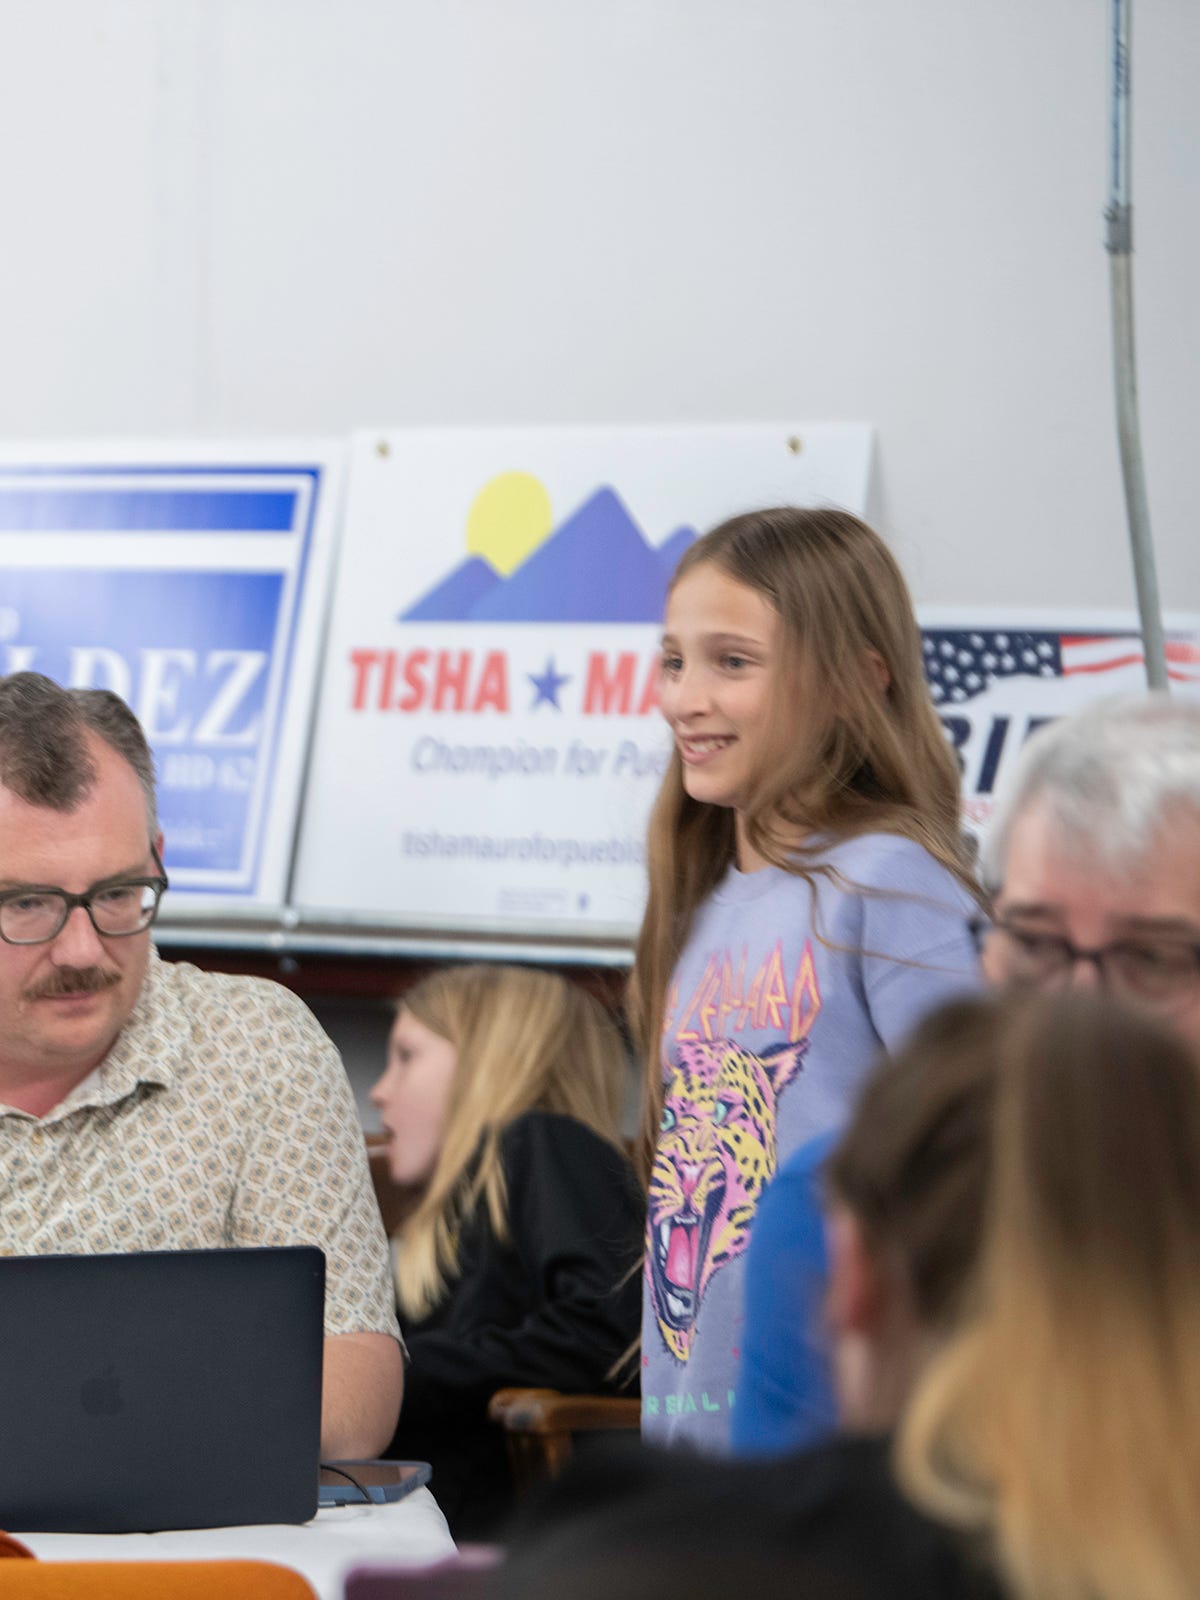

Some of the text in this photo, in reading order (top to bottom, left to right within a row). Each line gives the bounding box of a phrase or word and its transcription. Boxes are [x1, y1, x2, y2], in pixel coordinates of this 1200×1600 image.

[350, 648, 663, 716] TISHA MA
[411, 735, 558, 780] Champion
[564, 738, 608, 776] for
